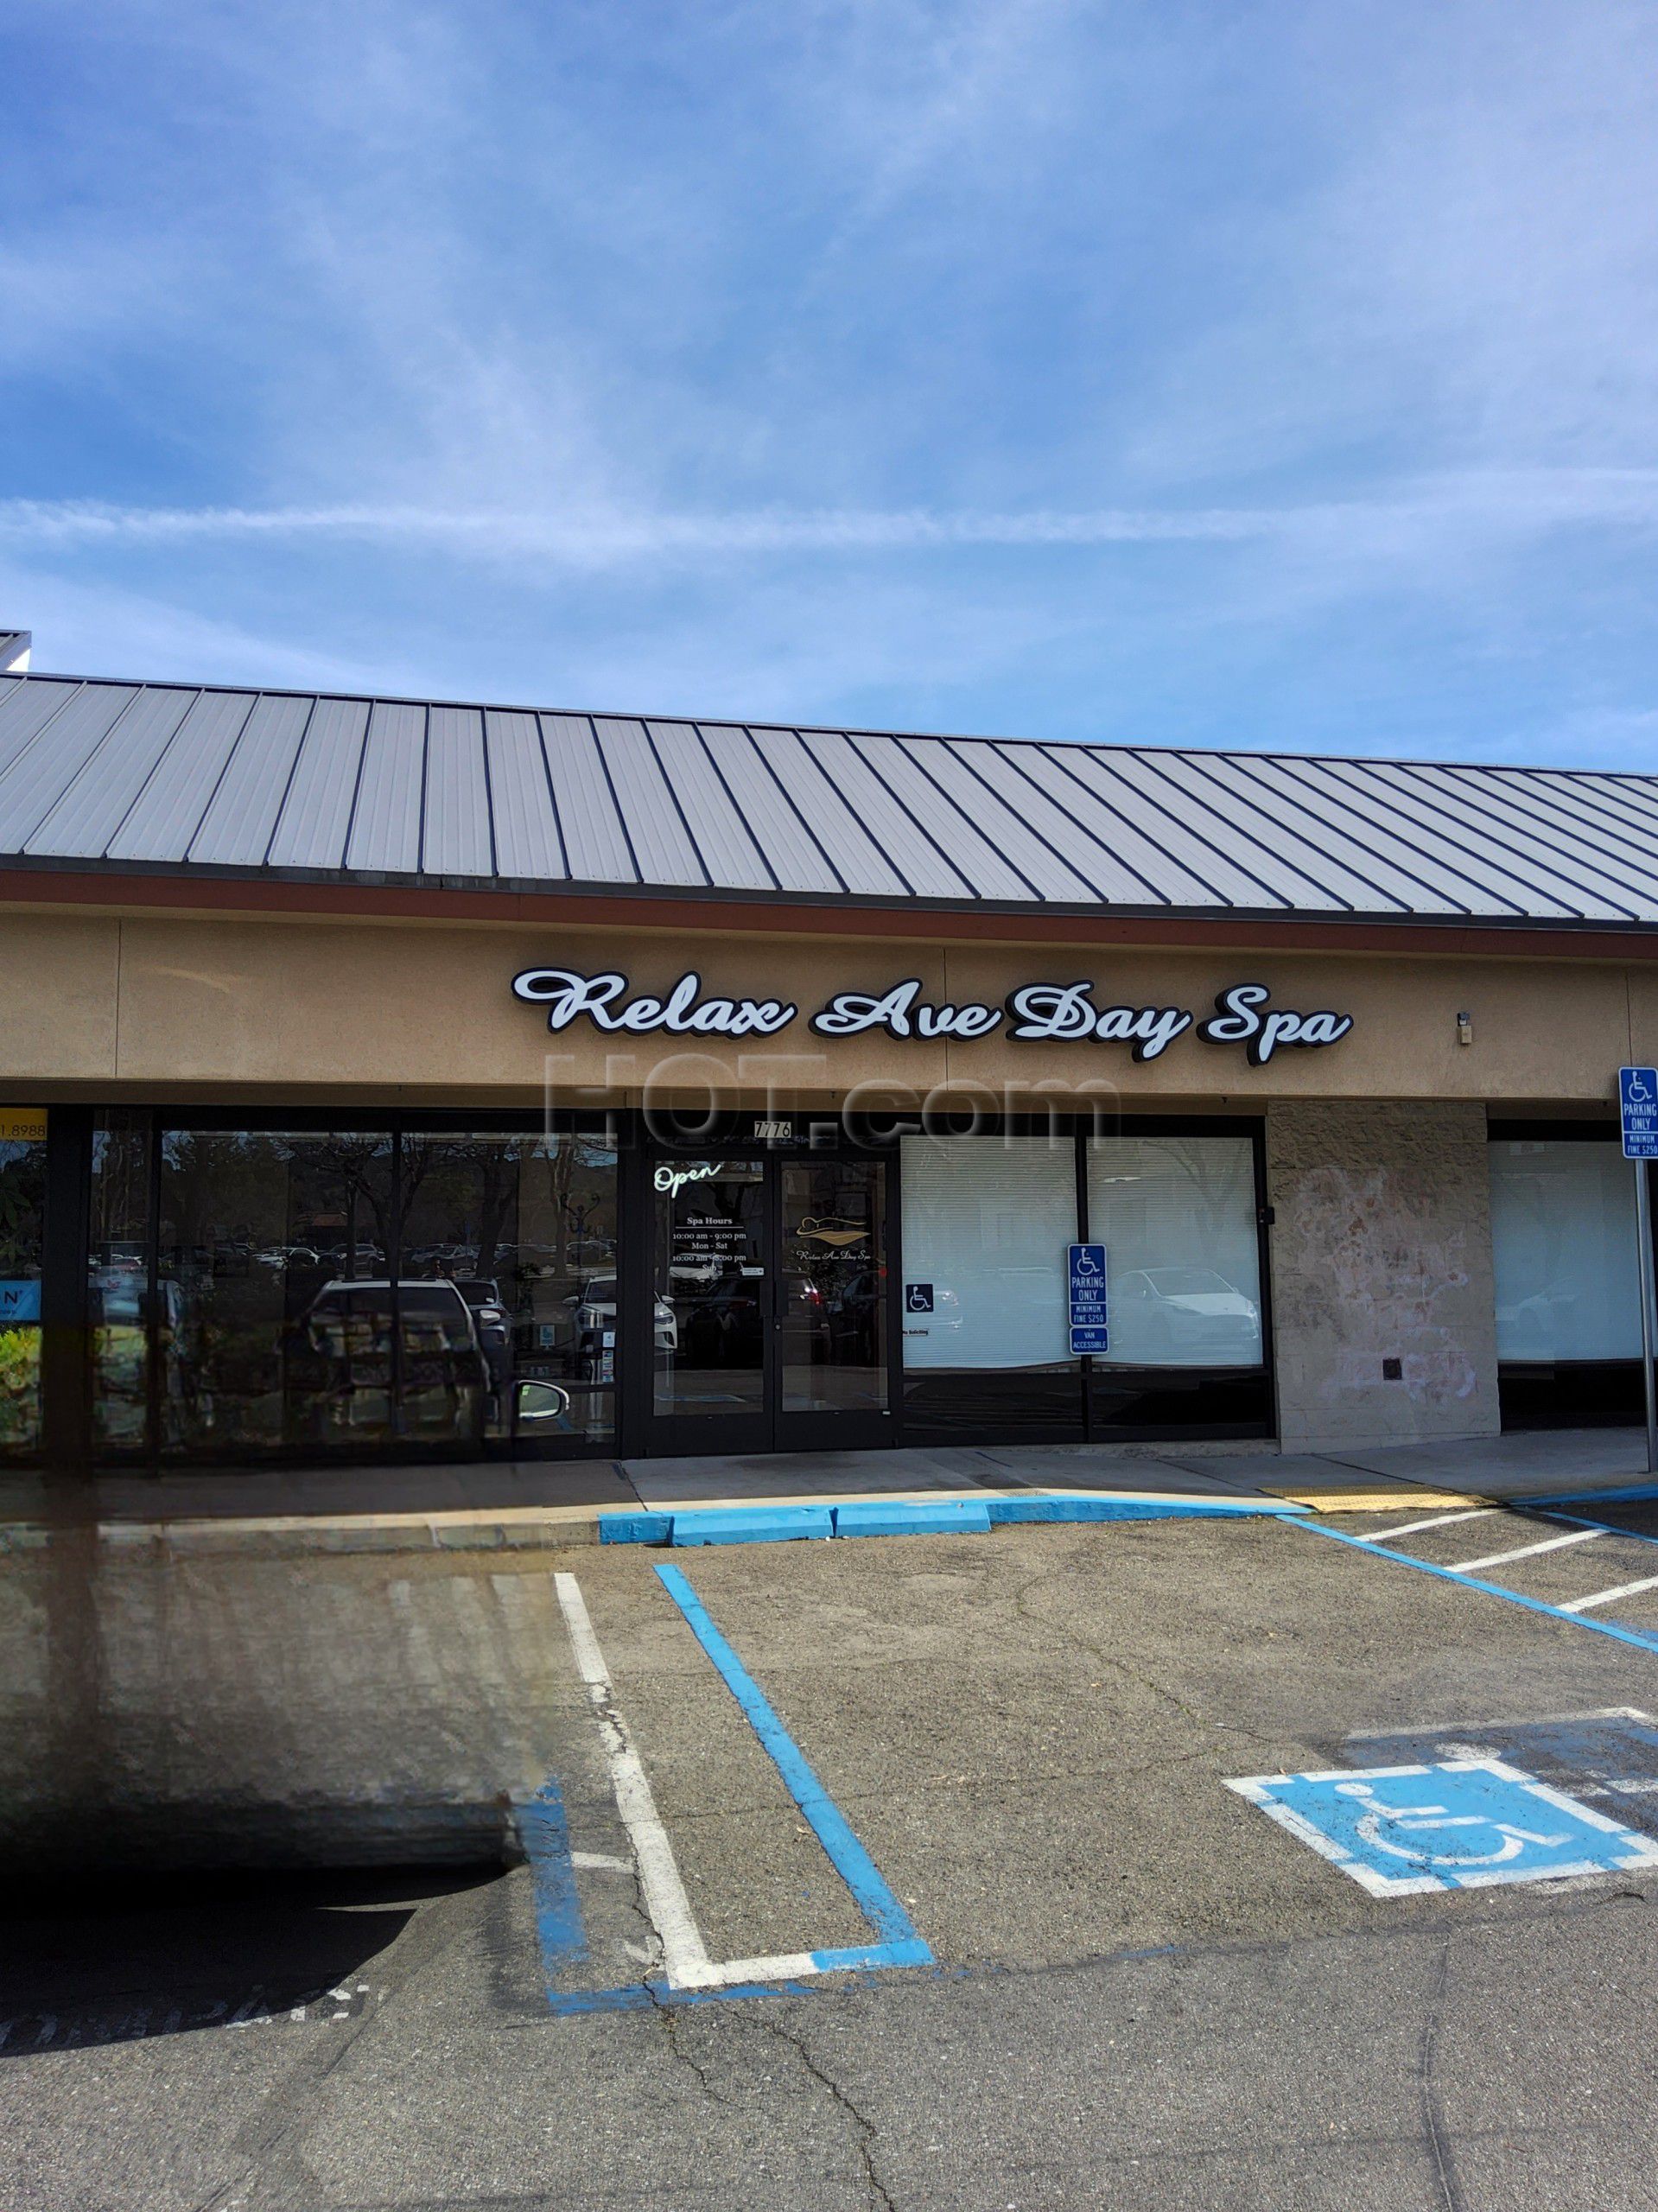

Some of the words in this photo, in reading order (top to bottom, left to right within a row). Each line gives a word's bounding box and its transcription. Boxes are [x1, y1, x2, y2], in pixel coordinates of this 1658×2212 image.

[511, 967, 797, 1035] Relax
[810, 978, 1003, 1040] Ave
[1006, 980, 1191, 1062] Day
[1198, 982, 1353, 1066] Spa
[1624, 1103, 1657, 1116] PARKING
[755, 1122, 791, 1137] 7776
[1631, 1117, 1651, 1130] ONLY
[1629, 1135, 1655, 1143] MINIMUM
[1627, 1145, 1641, 1154] FINE
[1642, 1145, 1658, 1154] $250
[654, 1161, 724, 1198] Open
[686, 1217, 703, 1226] Spa
[1071, 1276, 1104, 1288] PARKING
[1078, 1289, 1098, 1301] ONLY
[1073, 1314, 1087, 1323] FINE
[1088, 1314, 1104, 1323] $250
[1073, 1340, 1107, 1349] ACCESSIBLE
